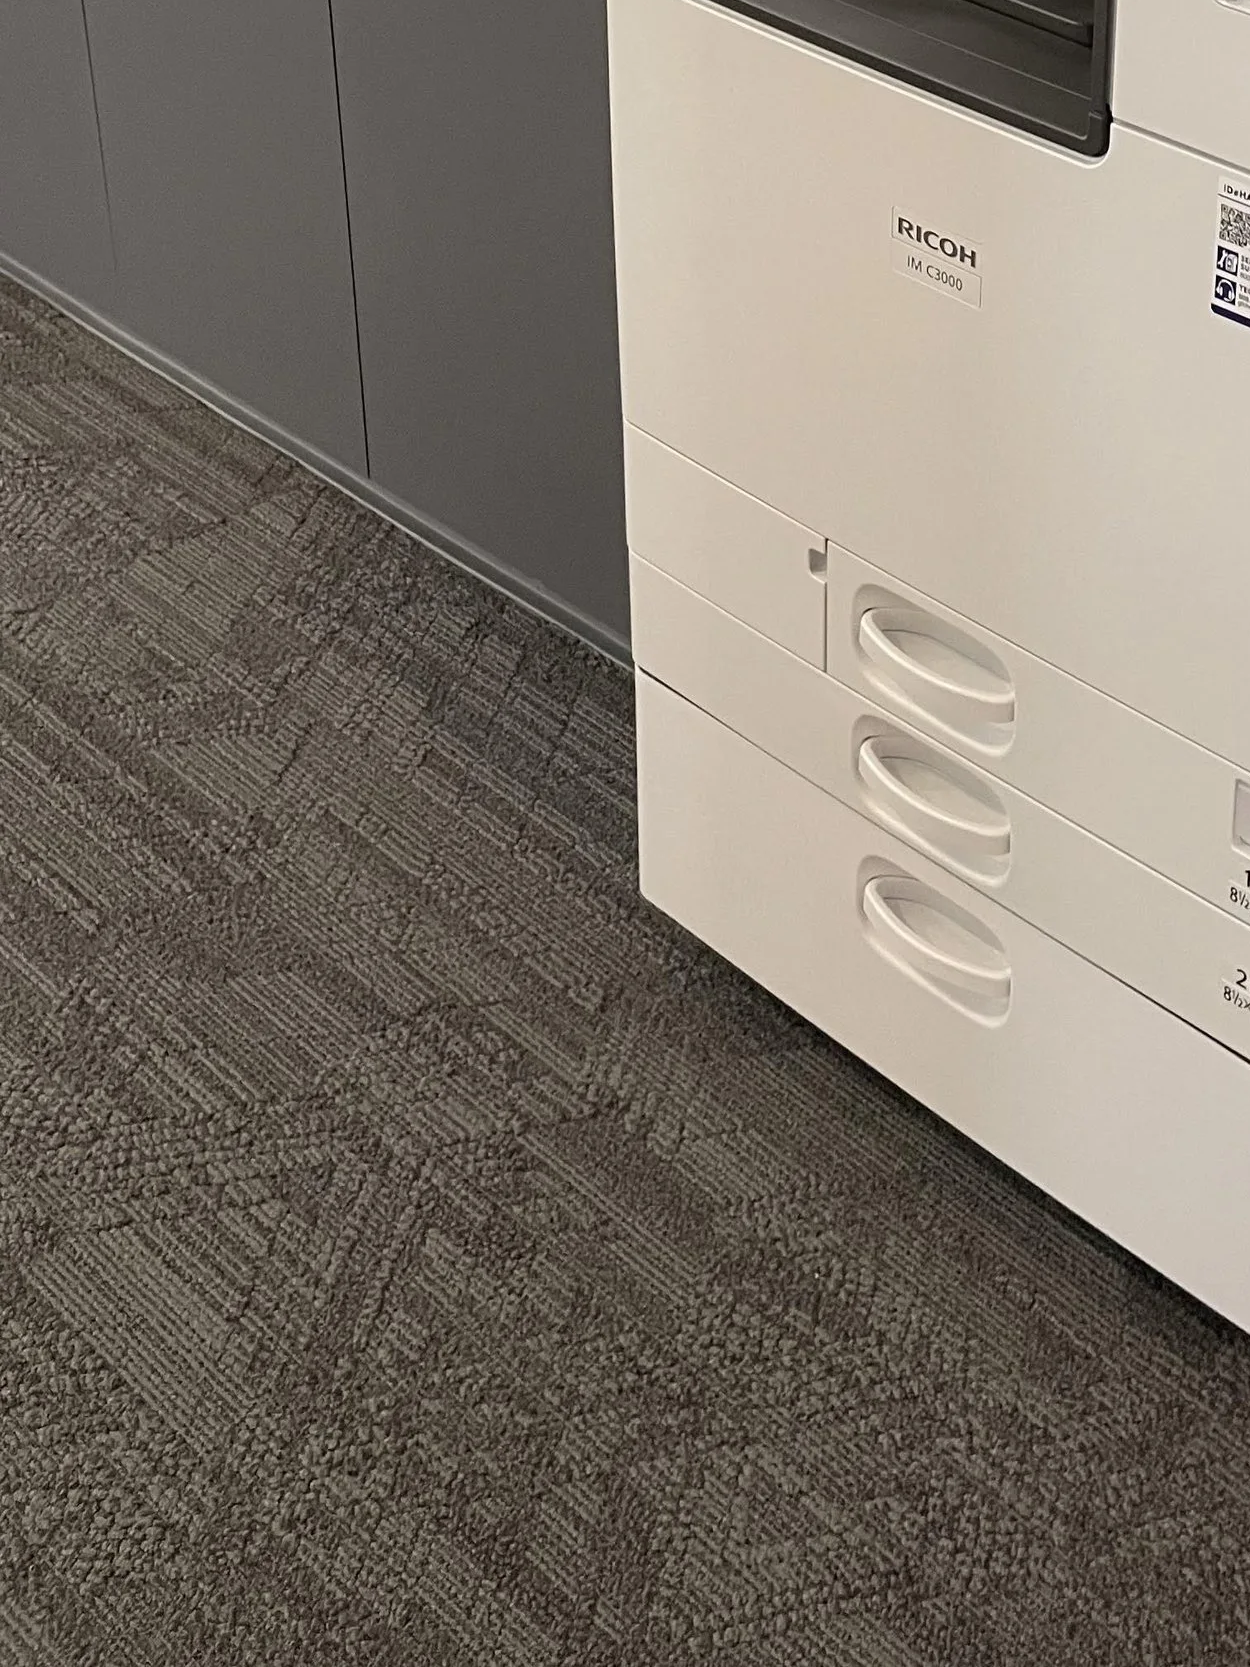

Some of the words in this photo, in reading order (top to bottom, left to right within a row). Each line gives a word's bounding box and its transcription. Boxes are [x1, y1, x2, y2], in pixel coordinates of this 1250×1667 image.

[898, 216, 976, 268] RICOH
[907, 255, 923, 274] IM
[926, 265, 963, 292] C3000
[1244, 869, 1250, 888] 1
[1235, 968, 1248, 990] 2
